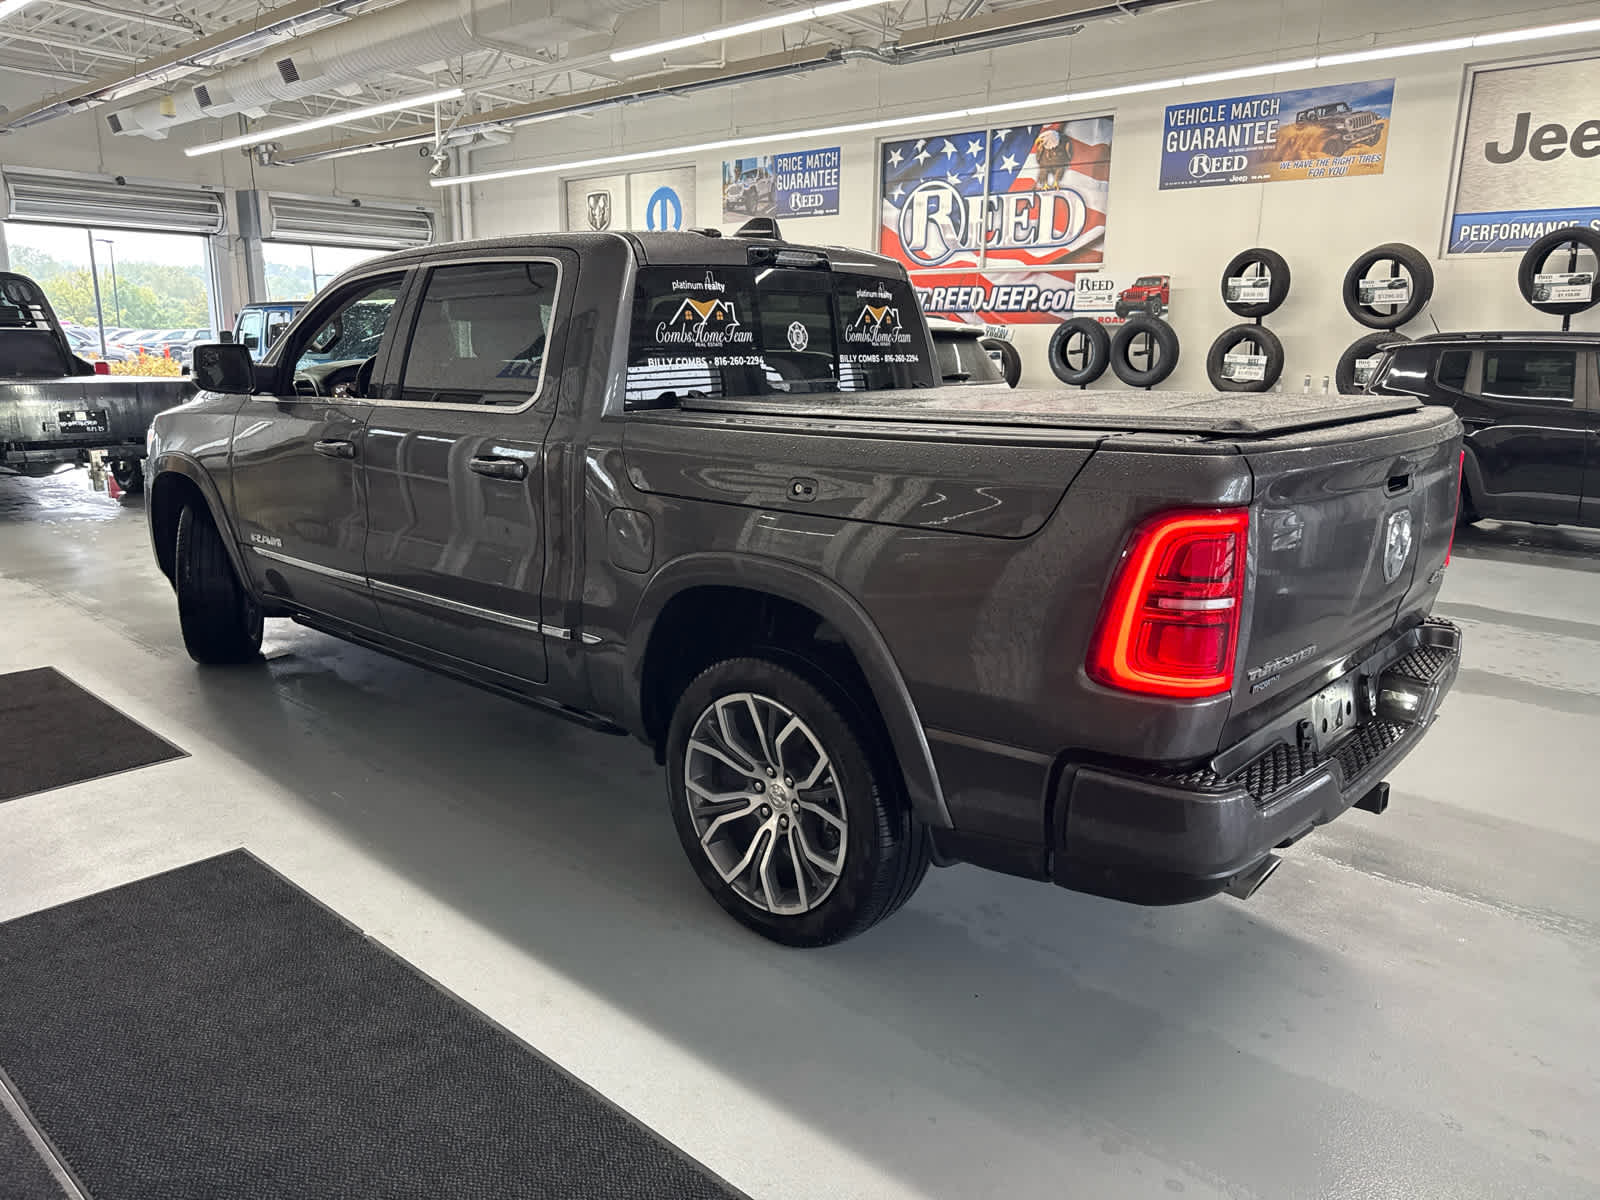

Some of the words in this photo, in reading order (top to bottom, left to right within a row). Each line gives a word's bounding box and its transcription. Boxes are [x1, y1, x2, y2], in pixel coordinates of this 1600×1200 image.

[1169, 105, 1227, 127] VEHICLE
[1231, 98, 1280, 120] MATCH
[1166, 120, 1279, 152] GUARANTEE
[777, 155, 803, 173] PRICE
[806, 151, 838, 170] MATCH
[1190, 154, 1248, 176] REED
[1280, 160, 1293, 170] WE
[1293, 159, 1314, 169] HAVE
[1315, 158, 1331, 167] THE
[1331, 156, 1356, 166] RIGHT
[1358, 153, 1382, 164] TIRES
[776, 168, 838, 191] GUARANTEE
[1229, 175, 1248, 183] Jeep
[1307, 167, 1325, 177] FOR
[1327, 166, 1349, 177] YOU!
[790, 192, 824, 210] REED
[901, 183, 1086, 261] REED
[672, 280, 703, 291] platinum
[704, 281, 725, 293] realty
[1079, 277, 1114, 292] REED
[856, 289, 877, 299] platinum
[1097, 316, 1126, 324] ROAD
[648, 357, 673, 368] BILLY
[676, 356, 707, 367] COMBS
[714, 355, 765, 367] 816-260-2294
[839, 354, 857, 362] BILLY
[858, 354, 880, 362] COMBS
